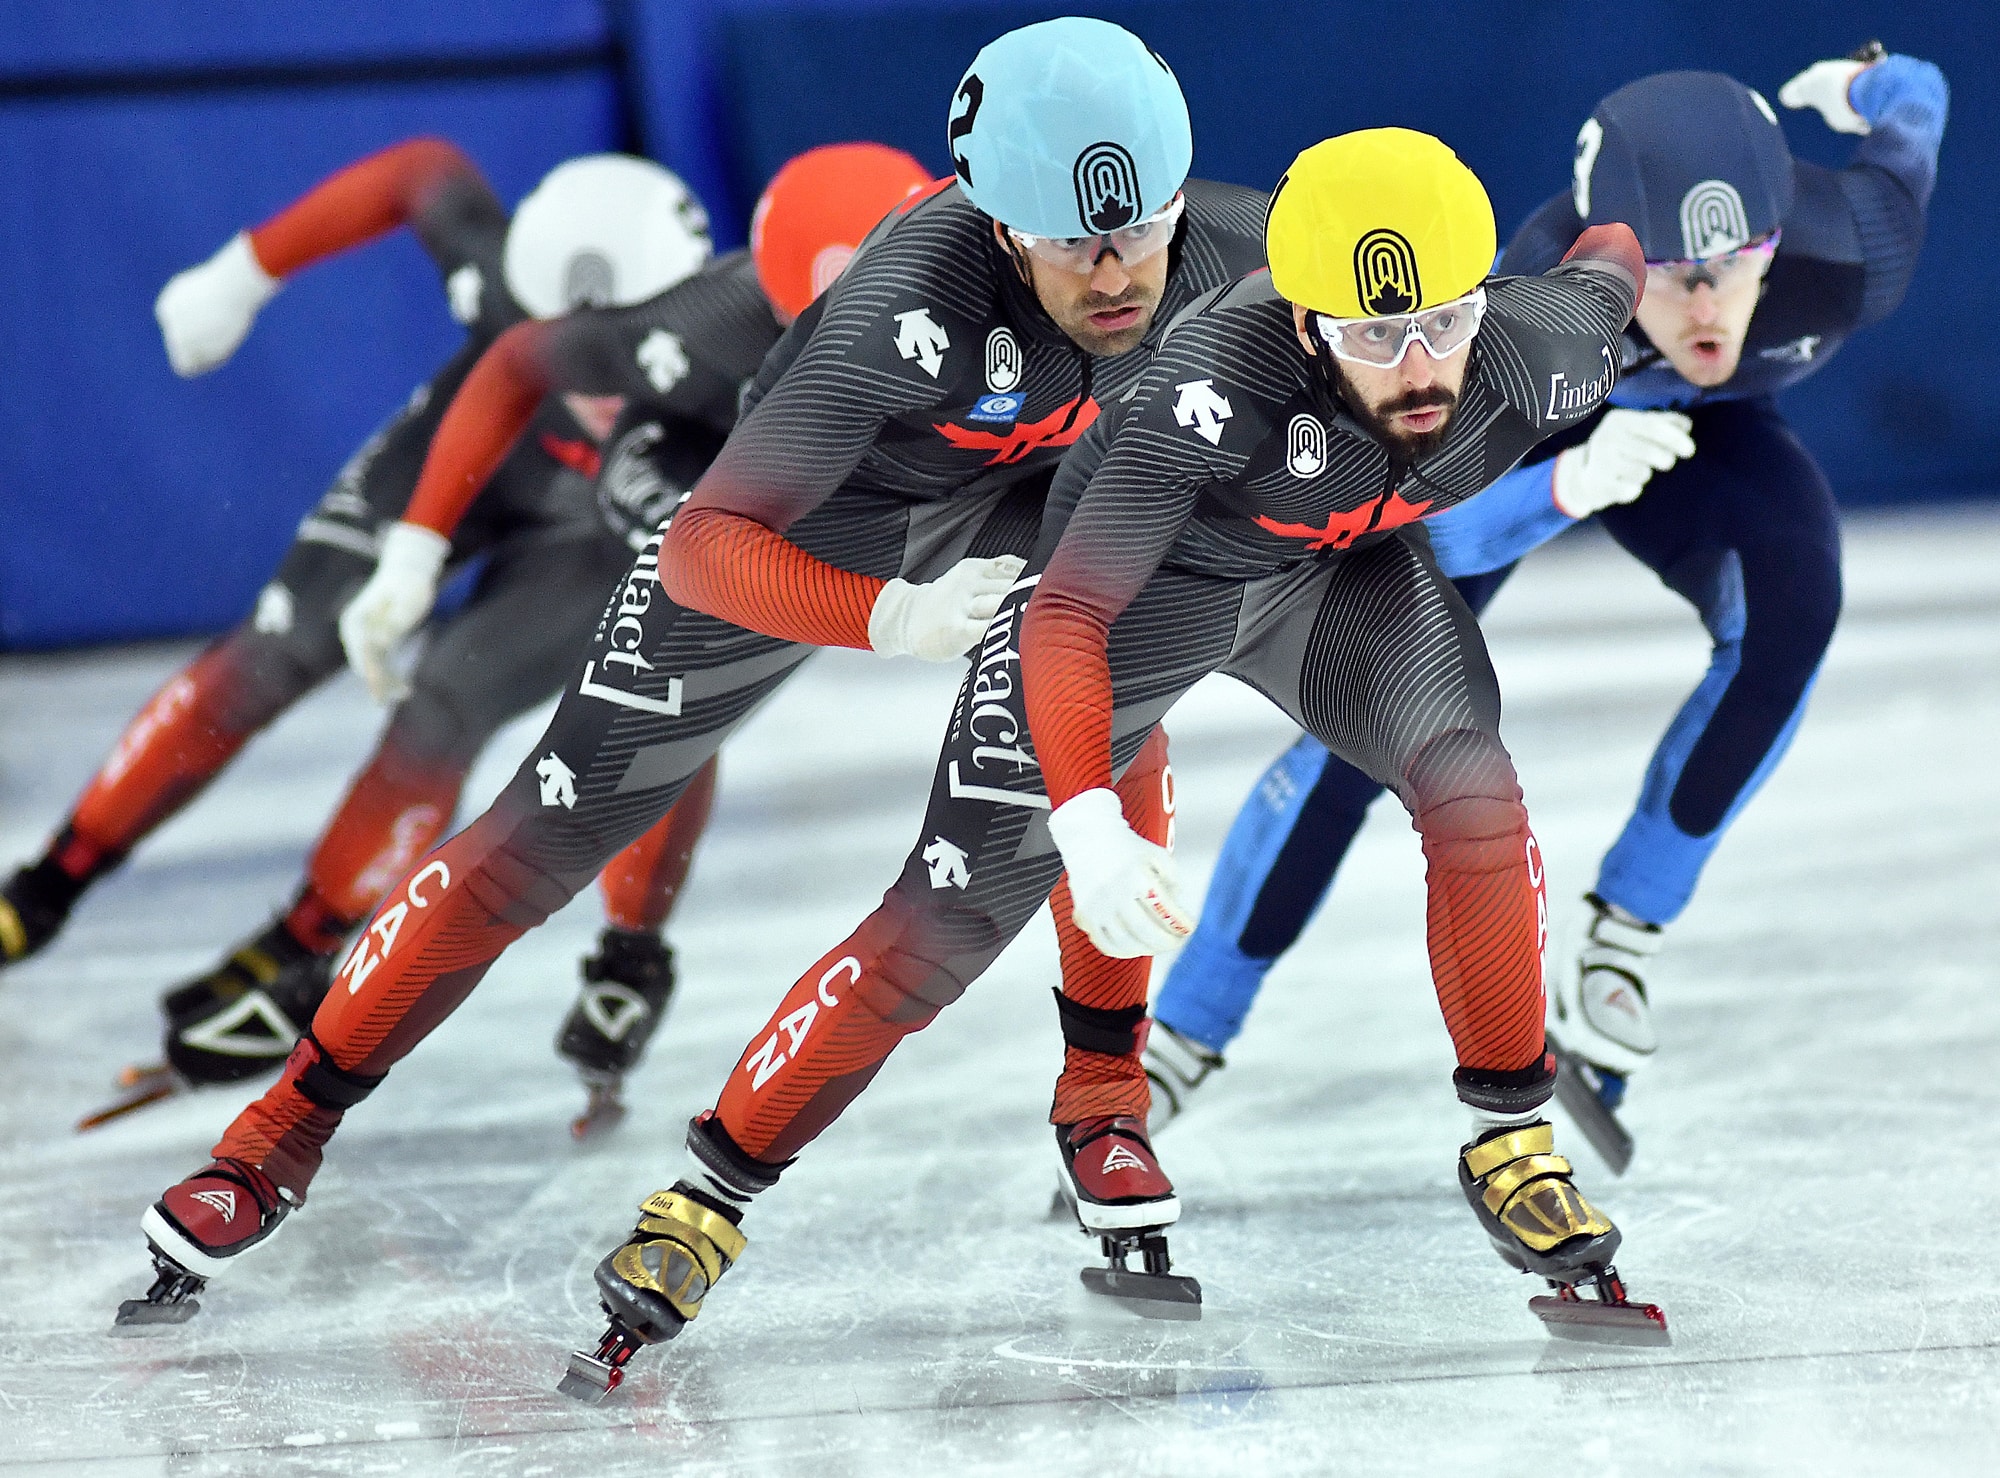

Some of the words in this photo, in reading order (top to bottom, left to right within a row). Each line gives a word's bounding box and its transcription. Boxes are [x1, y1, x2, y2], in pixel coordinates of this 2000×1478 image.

[950, 74, 984, 188] 2
[341, 859, 450, 996] CAN
[745, 955, 861, 1093] CAN
